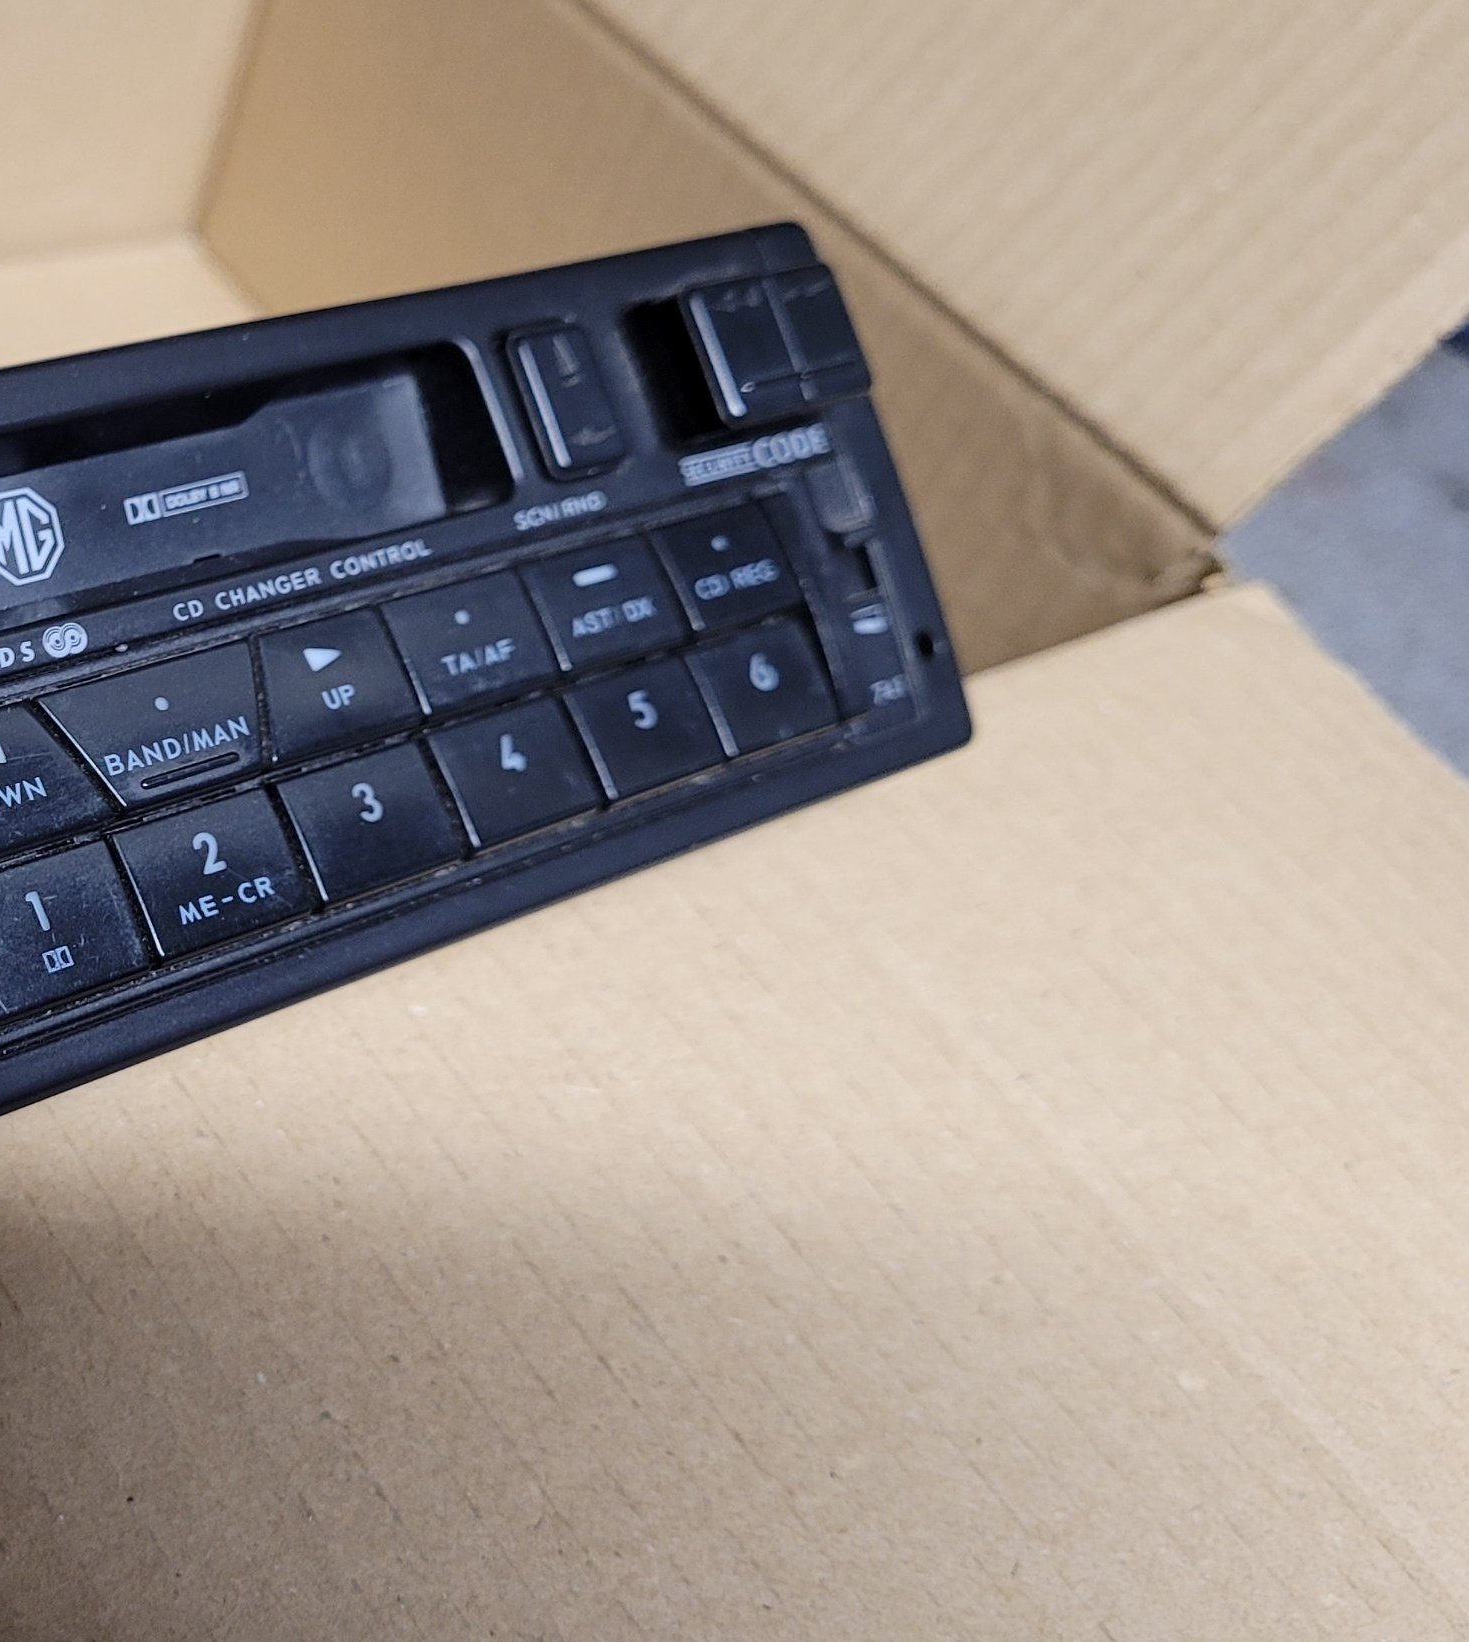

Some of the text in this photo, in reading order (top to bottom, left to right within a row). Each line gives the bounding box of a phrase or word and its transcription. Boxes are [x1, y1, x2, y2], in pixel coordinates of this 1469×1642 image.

[752, 422, 831, 468] CODE
[172, 539, 433, 622] CD CHANGER CONTROL
[440, 638, 515, 676] TA/AF
[749, 653, 780, 691] 6
[321, 684, 355, 710] UP
[627, 690, 658, 729] 5
[103, 715, 250, 777] BAND/MAN
[500, 733, 527, 771] 4
[351, 782, 383, 822] 3
[192, 831, 227, 875] 2
[25, 890, 52, 932] 1
[178, 876, 276, 925] ME-CR
